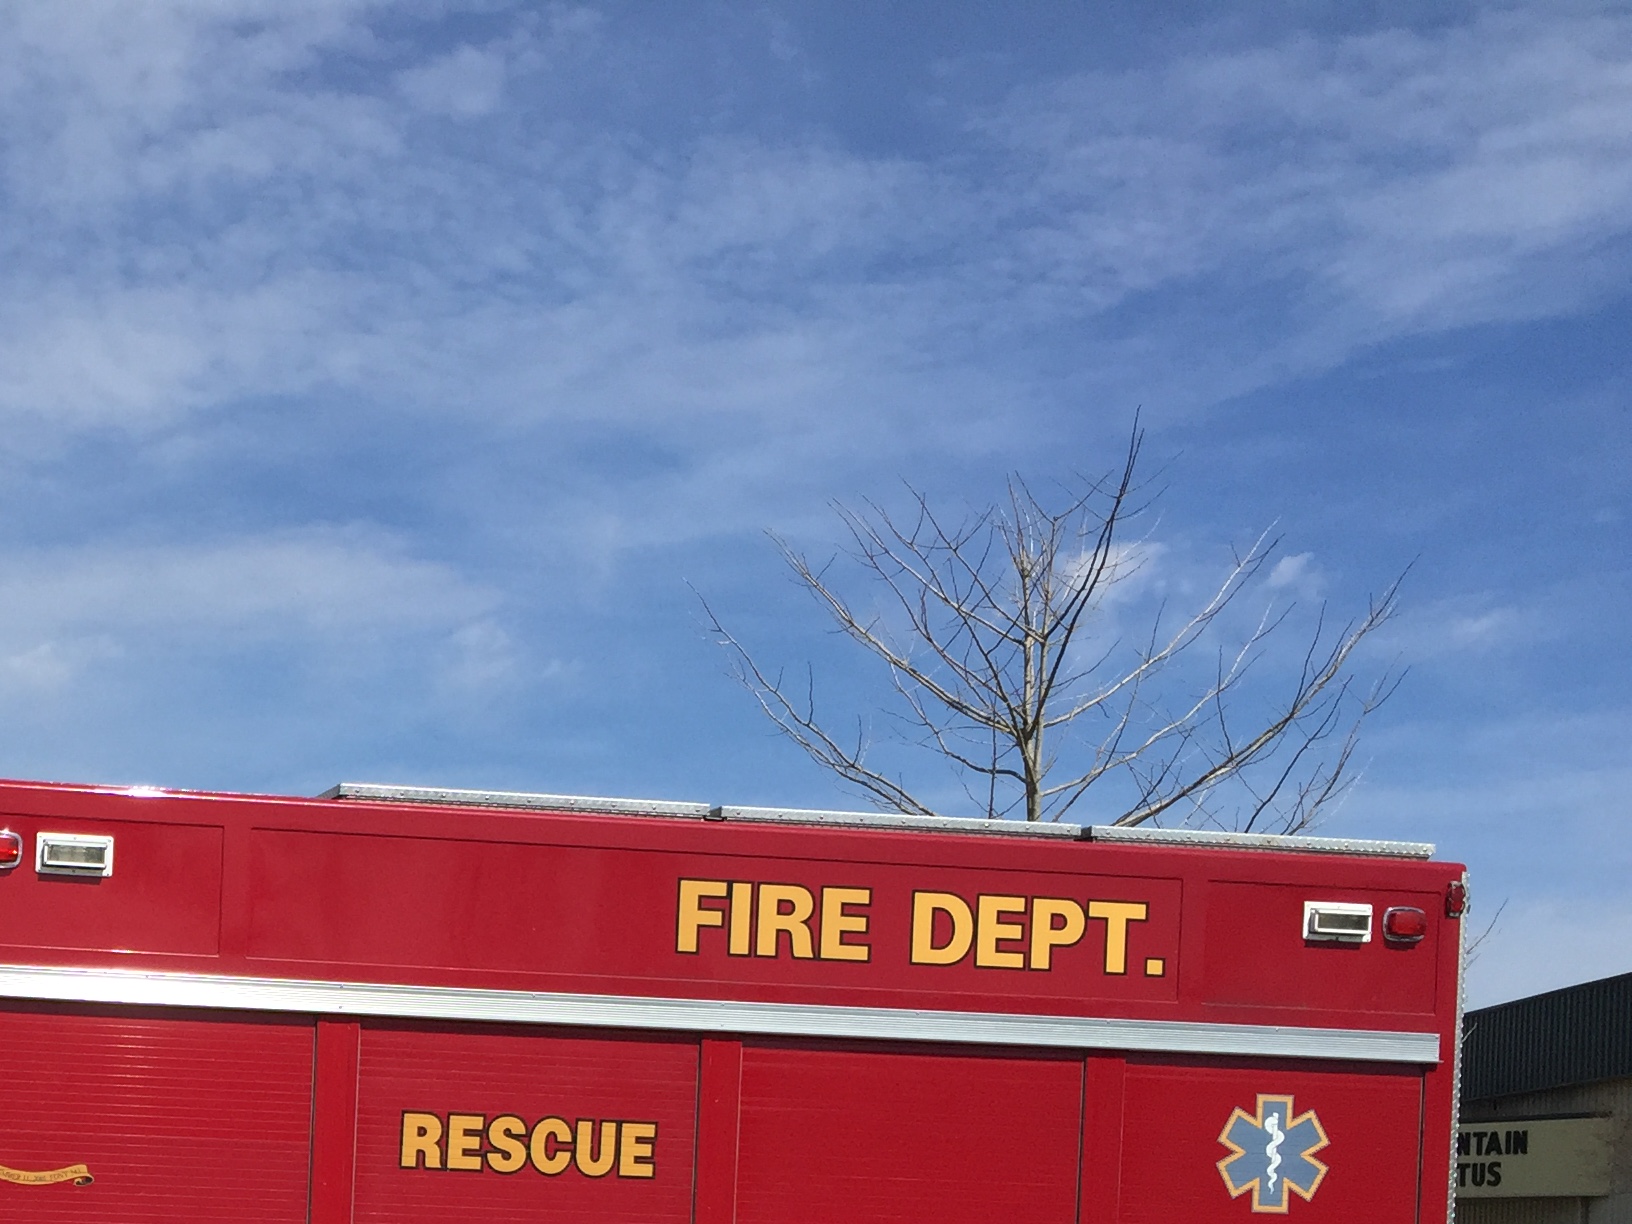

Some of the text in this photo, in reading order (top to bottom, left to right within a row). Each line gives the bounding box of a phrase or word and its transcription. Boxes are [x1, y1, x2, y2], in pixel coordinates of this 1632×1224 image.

[675, 877, 1166, 978] FIRE DEPT.
[399, 1110, 658, 1179] RESCUE
[1455, 1162, 1502, 1187] TUS
